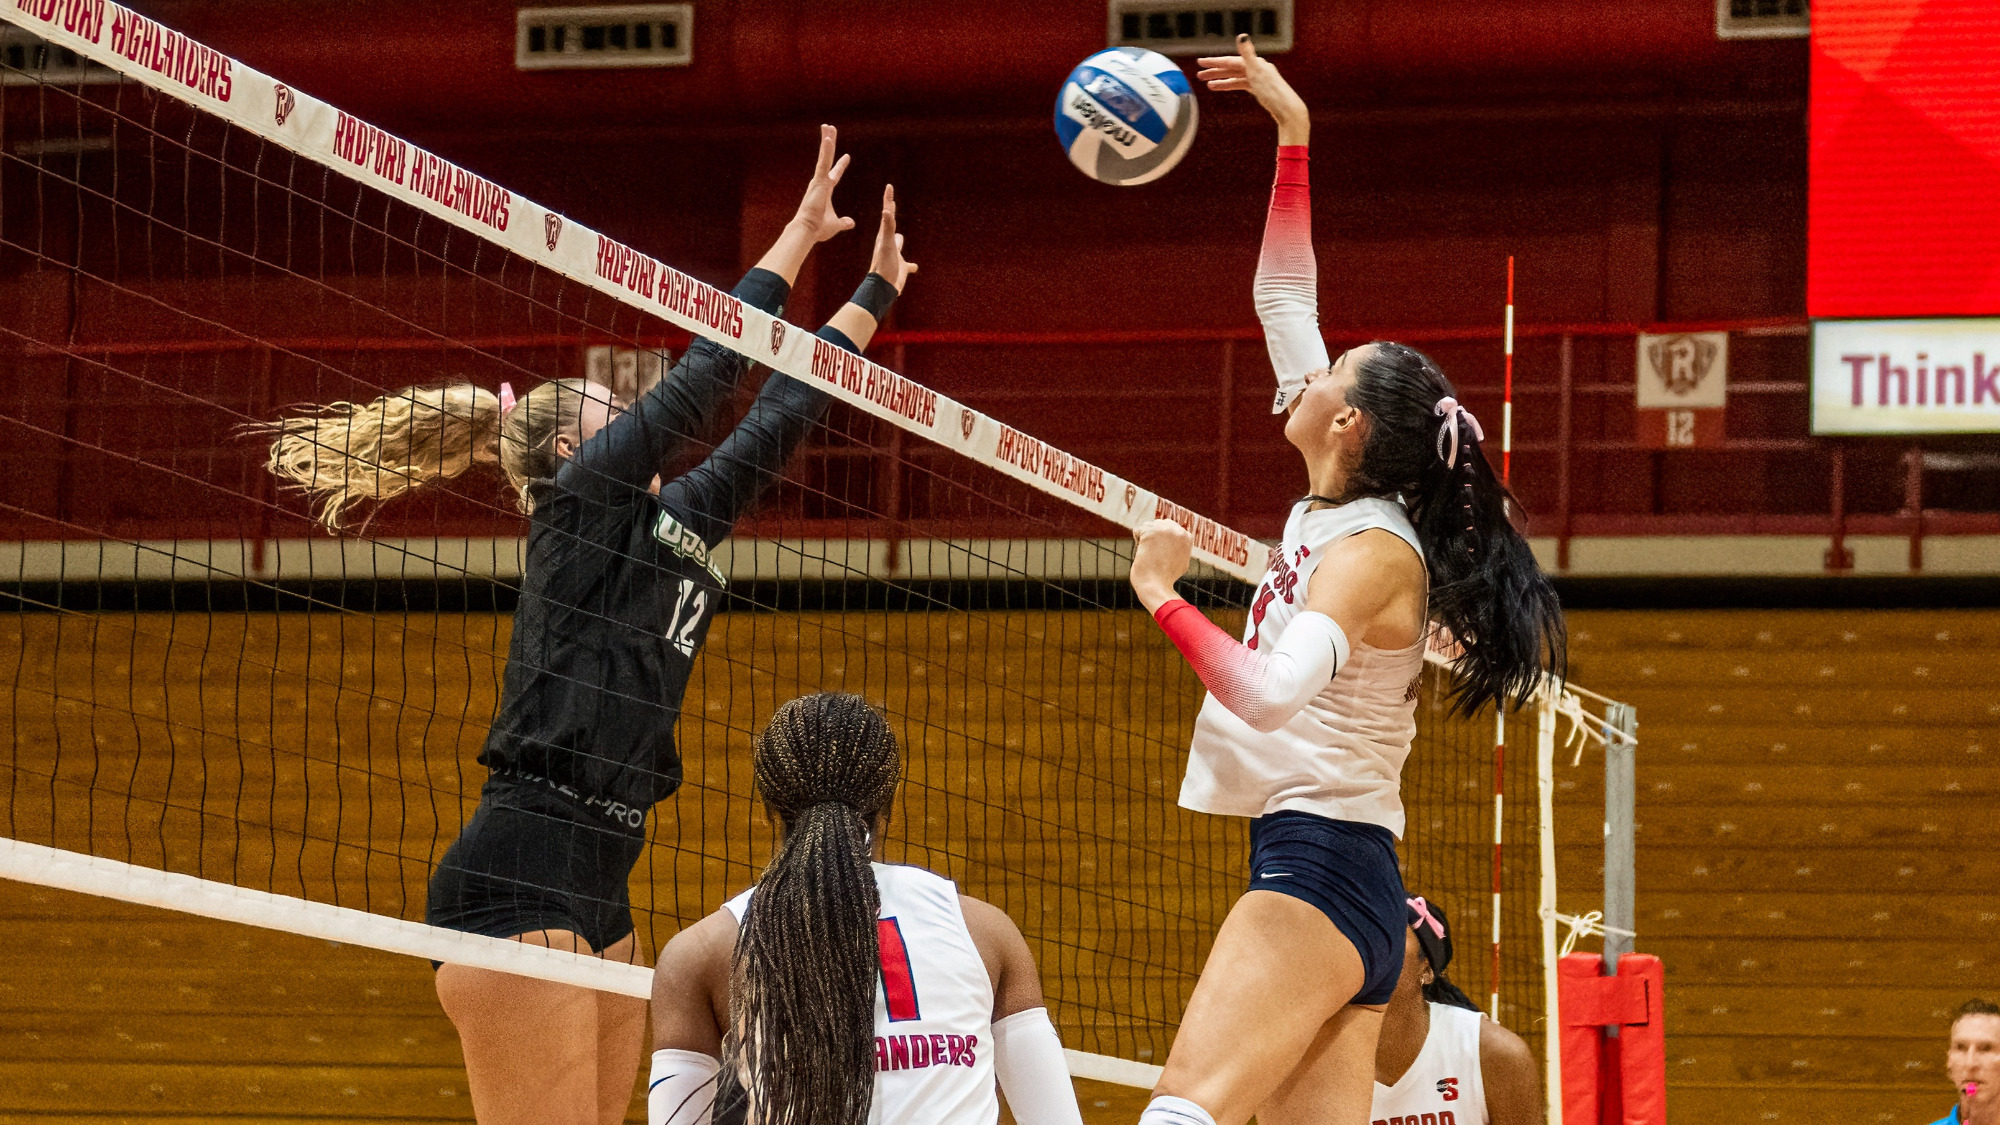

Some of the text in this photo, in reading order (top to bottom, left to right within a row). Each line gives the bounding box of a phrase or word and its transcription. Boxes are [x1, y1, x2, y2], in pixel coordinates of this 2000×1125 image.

[112, 5, 232, 102] HIGHLANDERS
[332, 110, 511, 232] RADFORD HIGHLANDERS
[595, 234, 743, 339] RADFORD HIGHLANDERS
[1841, 352, 2000, 407] Think
[665, 579, 708, 658] 12
[873, 1034, 979, 1073] ANDERS
